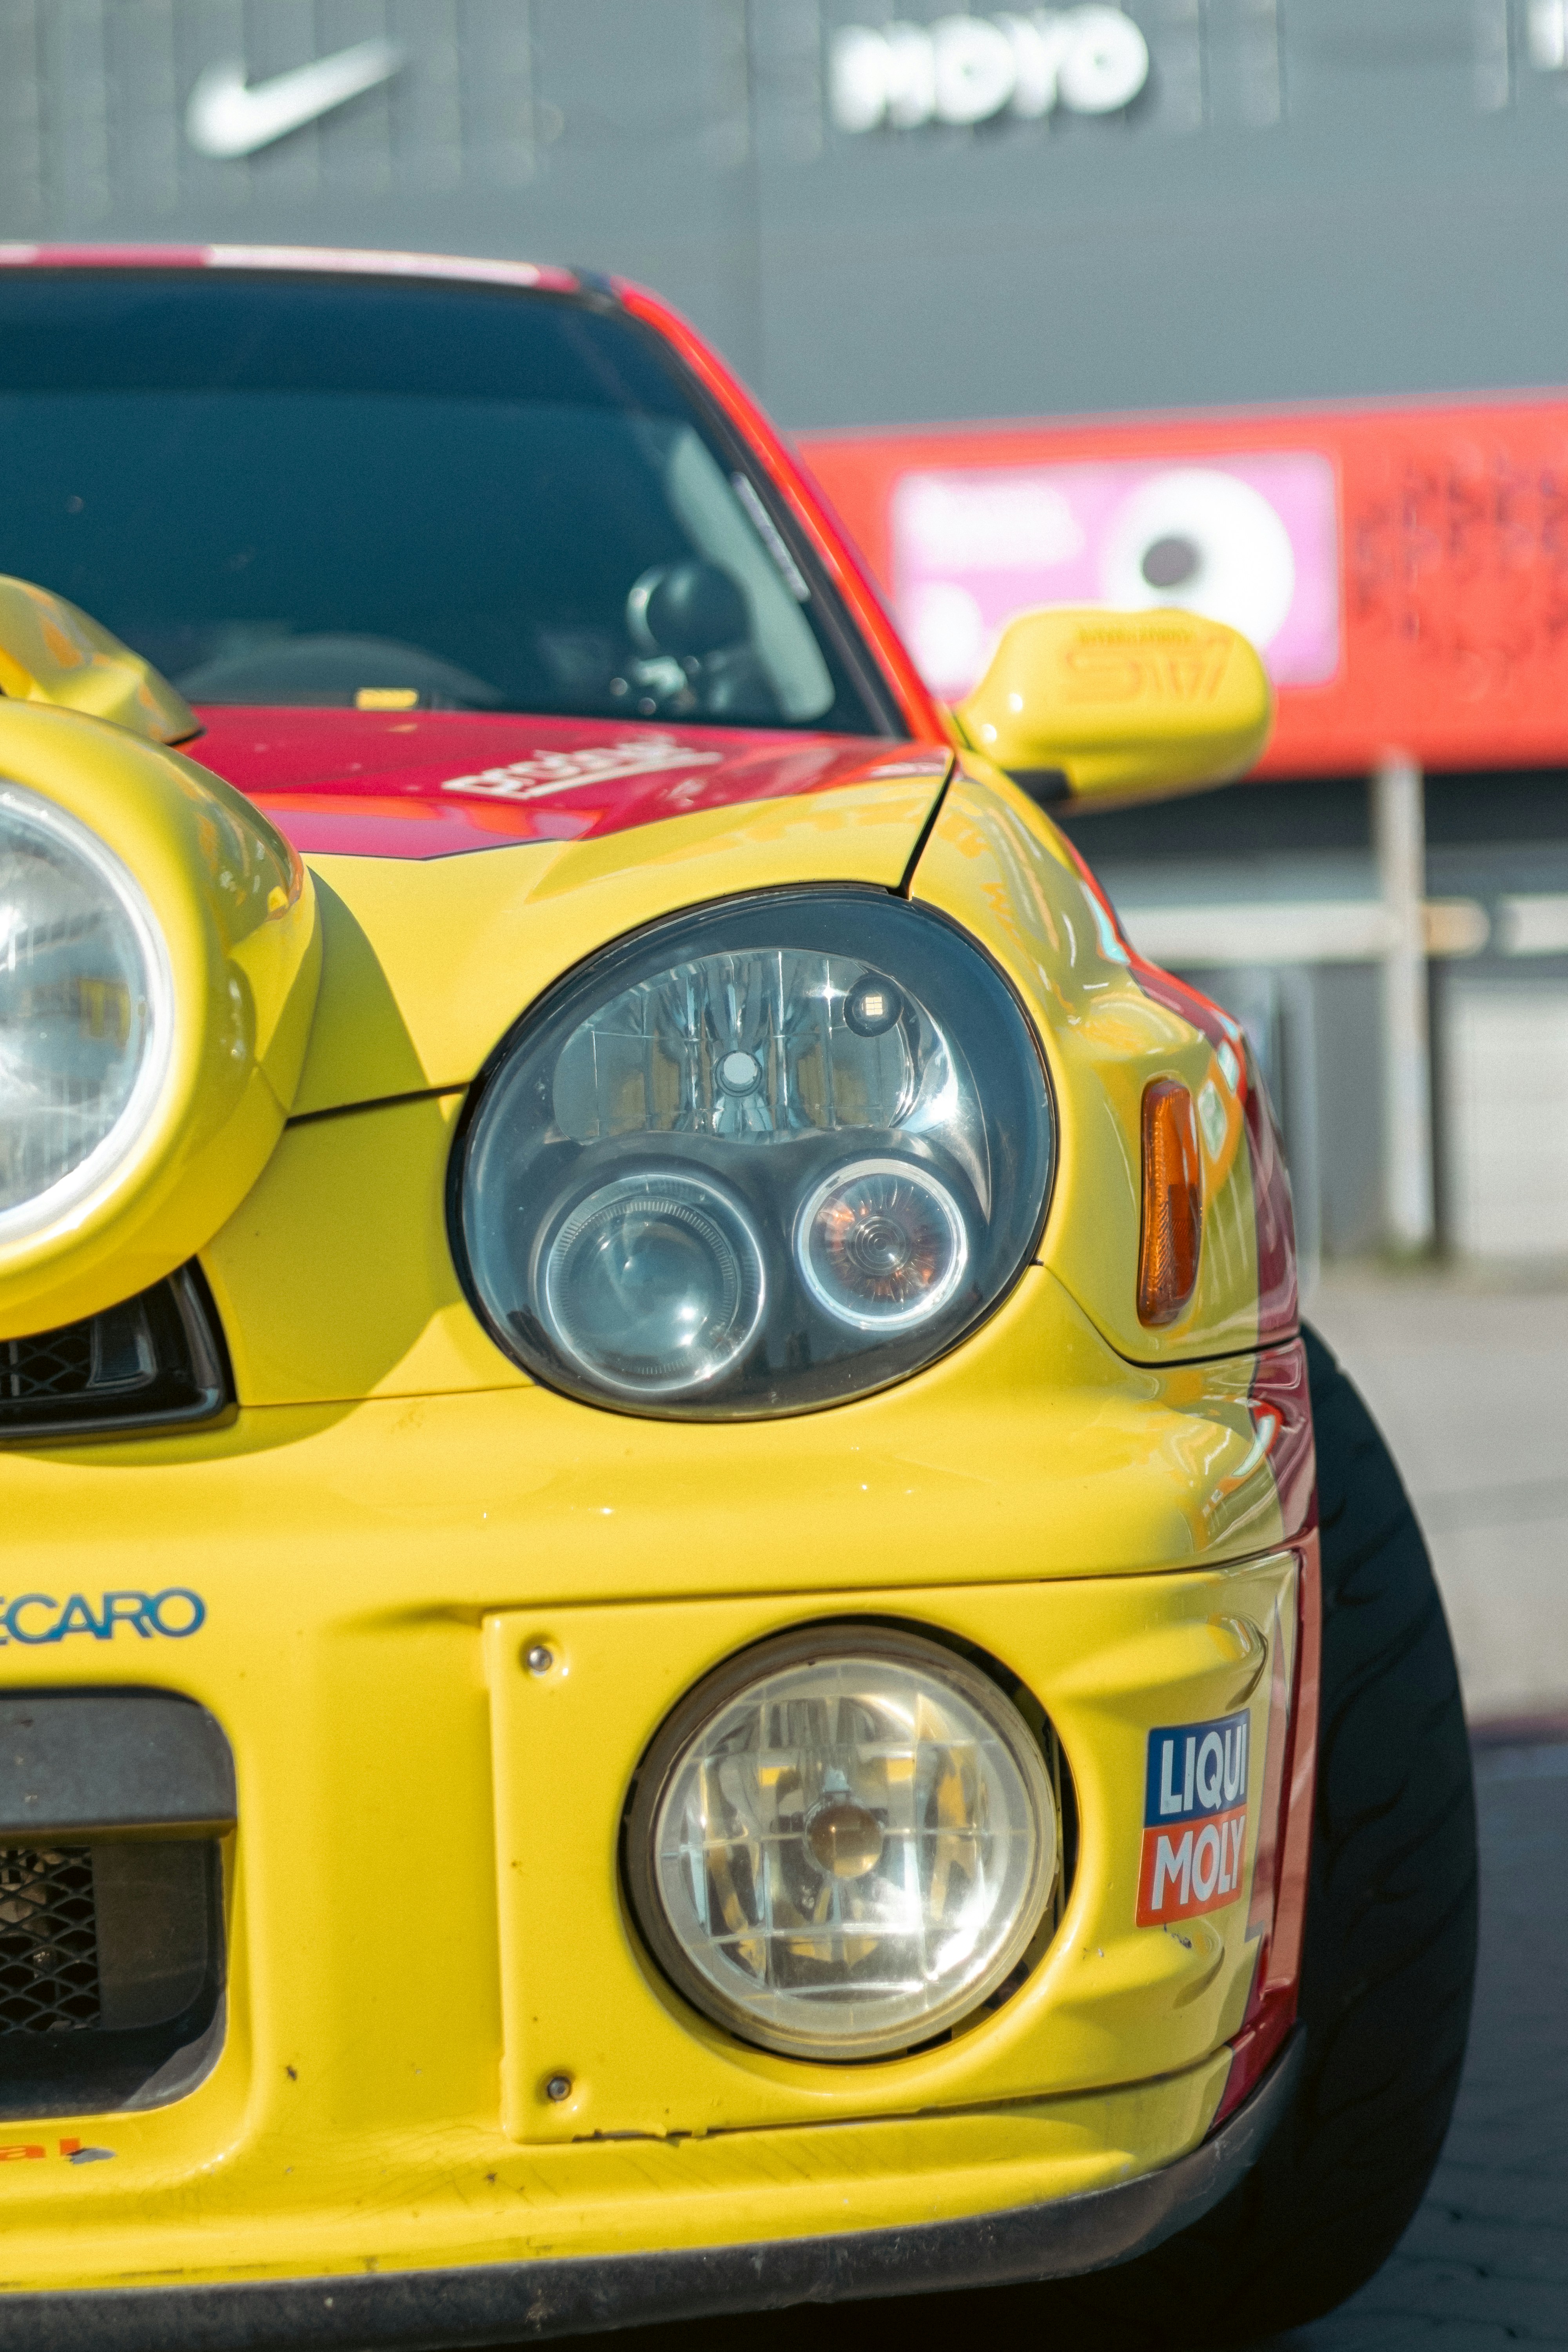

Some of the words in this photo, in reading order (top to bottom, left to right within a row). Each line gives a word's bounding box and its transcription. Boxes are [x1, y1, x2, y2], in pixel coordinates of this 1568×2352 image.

[0, 1588, 205, 1645] CARO
[1160, 1723, 1247, 1815] LIQUI
[1151, 1815, 1245, 1910] MOLY
